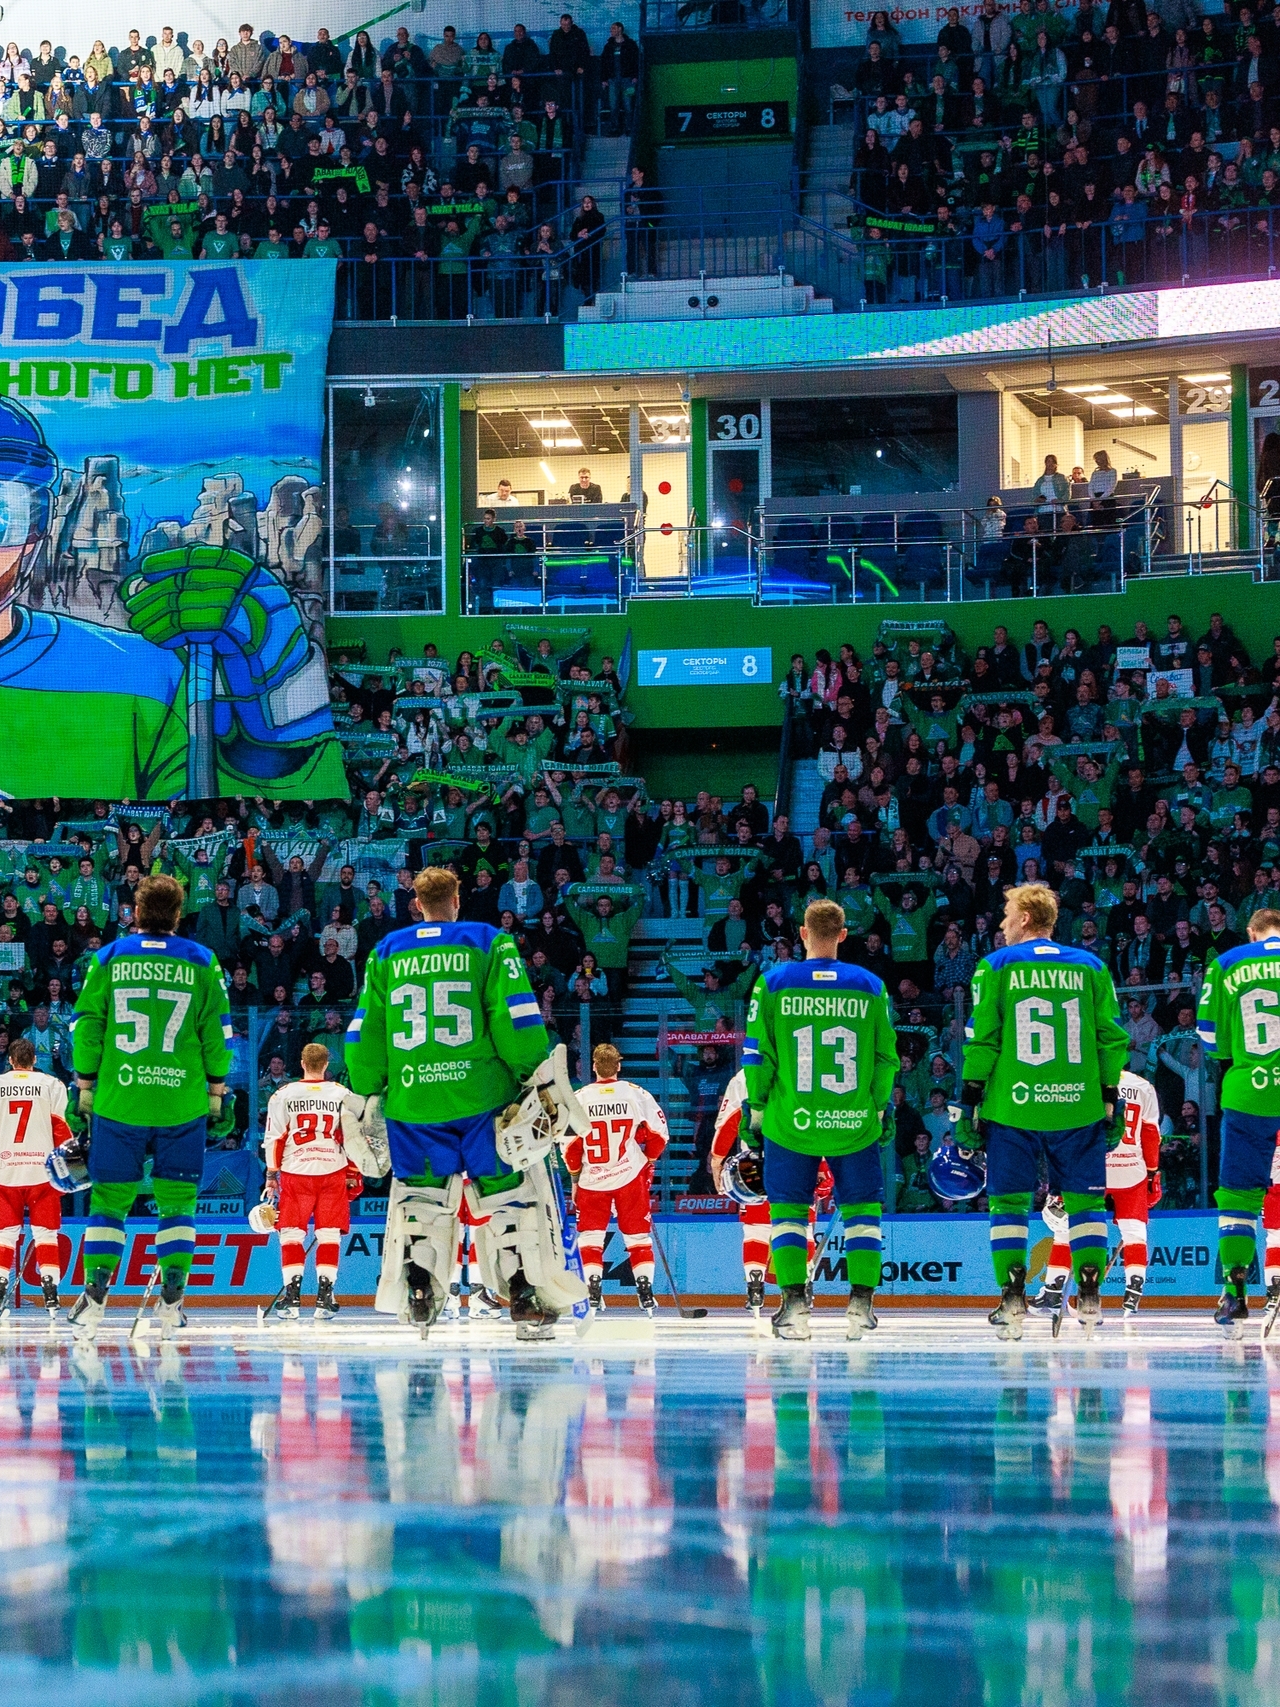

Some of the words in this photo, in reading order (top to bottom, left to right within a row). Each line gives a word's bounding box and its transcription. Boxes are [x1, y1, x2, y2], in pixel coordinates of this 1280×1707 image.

[677, 112, 692, 132] 7
[706, 111, 747, 120] СЕКТОРЫ
[761, 108, 775, 128] 8
[172, 351, 294, 398] НЕТ
[1186, 385, 1230, 414] 29
[1258, 379, 1280, 406] 2
[716, 413, 760, 441] 30
[652, 657, 668, 679] 7
[683, 657, 727, 666] СЕКТОРЫ
[741, 655, 759, 677] 8
[675, 848, 720, 858] САЛАВАТ
[724, 847, 759, 857] ЮЛАЕВ
[578, 886, 609, 894] САЛАВАТ
[609, 886, 633, 894] ЮЛАЕВ
[111, 962, 195, 986] BROSSEAU
[391, 952, 471, 980] VYAZOVOI
[1009, 969, 1084, 991] ALALYKIN
[389, 980, 474, 1051] 35
[780, 996, 869, 1019] GORSHKOV
[113, 987, 193, 1054] 57
[1015, 996, 1082, 1066] 61
[1239, 987, 1280, 1056] 6
[137, 1064, 187, 1078] САДОВОЕ
[418, 1060, 472, 1072] САДОВОЕ
[792, 1024, 858, 1095] 13
[137, 1075, 182, 1088] КОЛЬЦО
[418, 1071, 467, 1083] КОЛЬЦО
[1033, 1082, 1086, 1093] САДОВОЕ
[0, 1085, 42, 1098] BUSYGIN
[1033, 1092, 1081, 1103] КОЛЬЦО
[286, 1099, 342, 1114] KHRIPUNOV
[587, 1103, 629, 1117] KIZIMOV
[815, 1108, 869, 1119] САДОВОЕ
[8, 1100, 33, 1144] 7
[292, 1113, 336, 1147] 31
[815, 1119, 863, 1130] КОЛЬЦО
[1123, 1102, 1142, 1146] 9
[585, 1118, 634, 1165] 97
[193, 1201, 241, 1215] HL.RU
[678, 1198, 733, 1211] FONBET
[813, 1256, 963, 1285] Мркет
